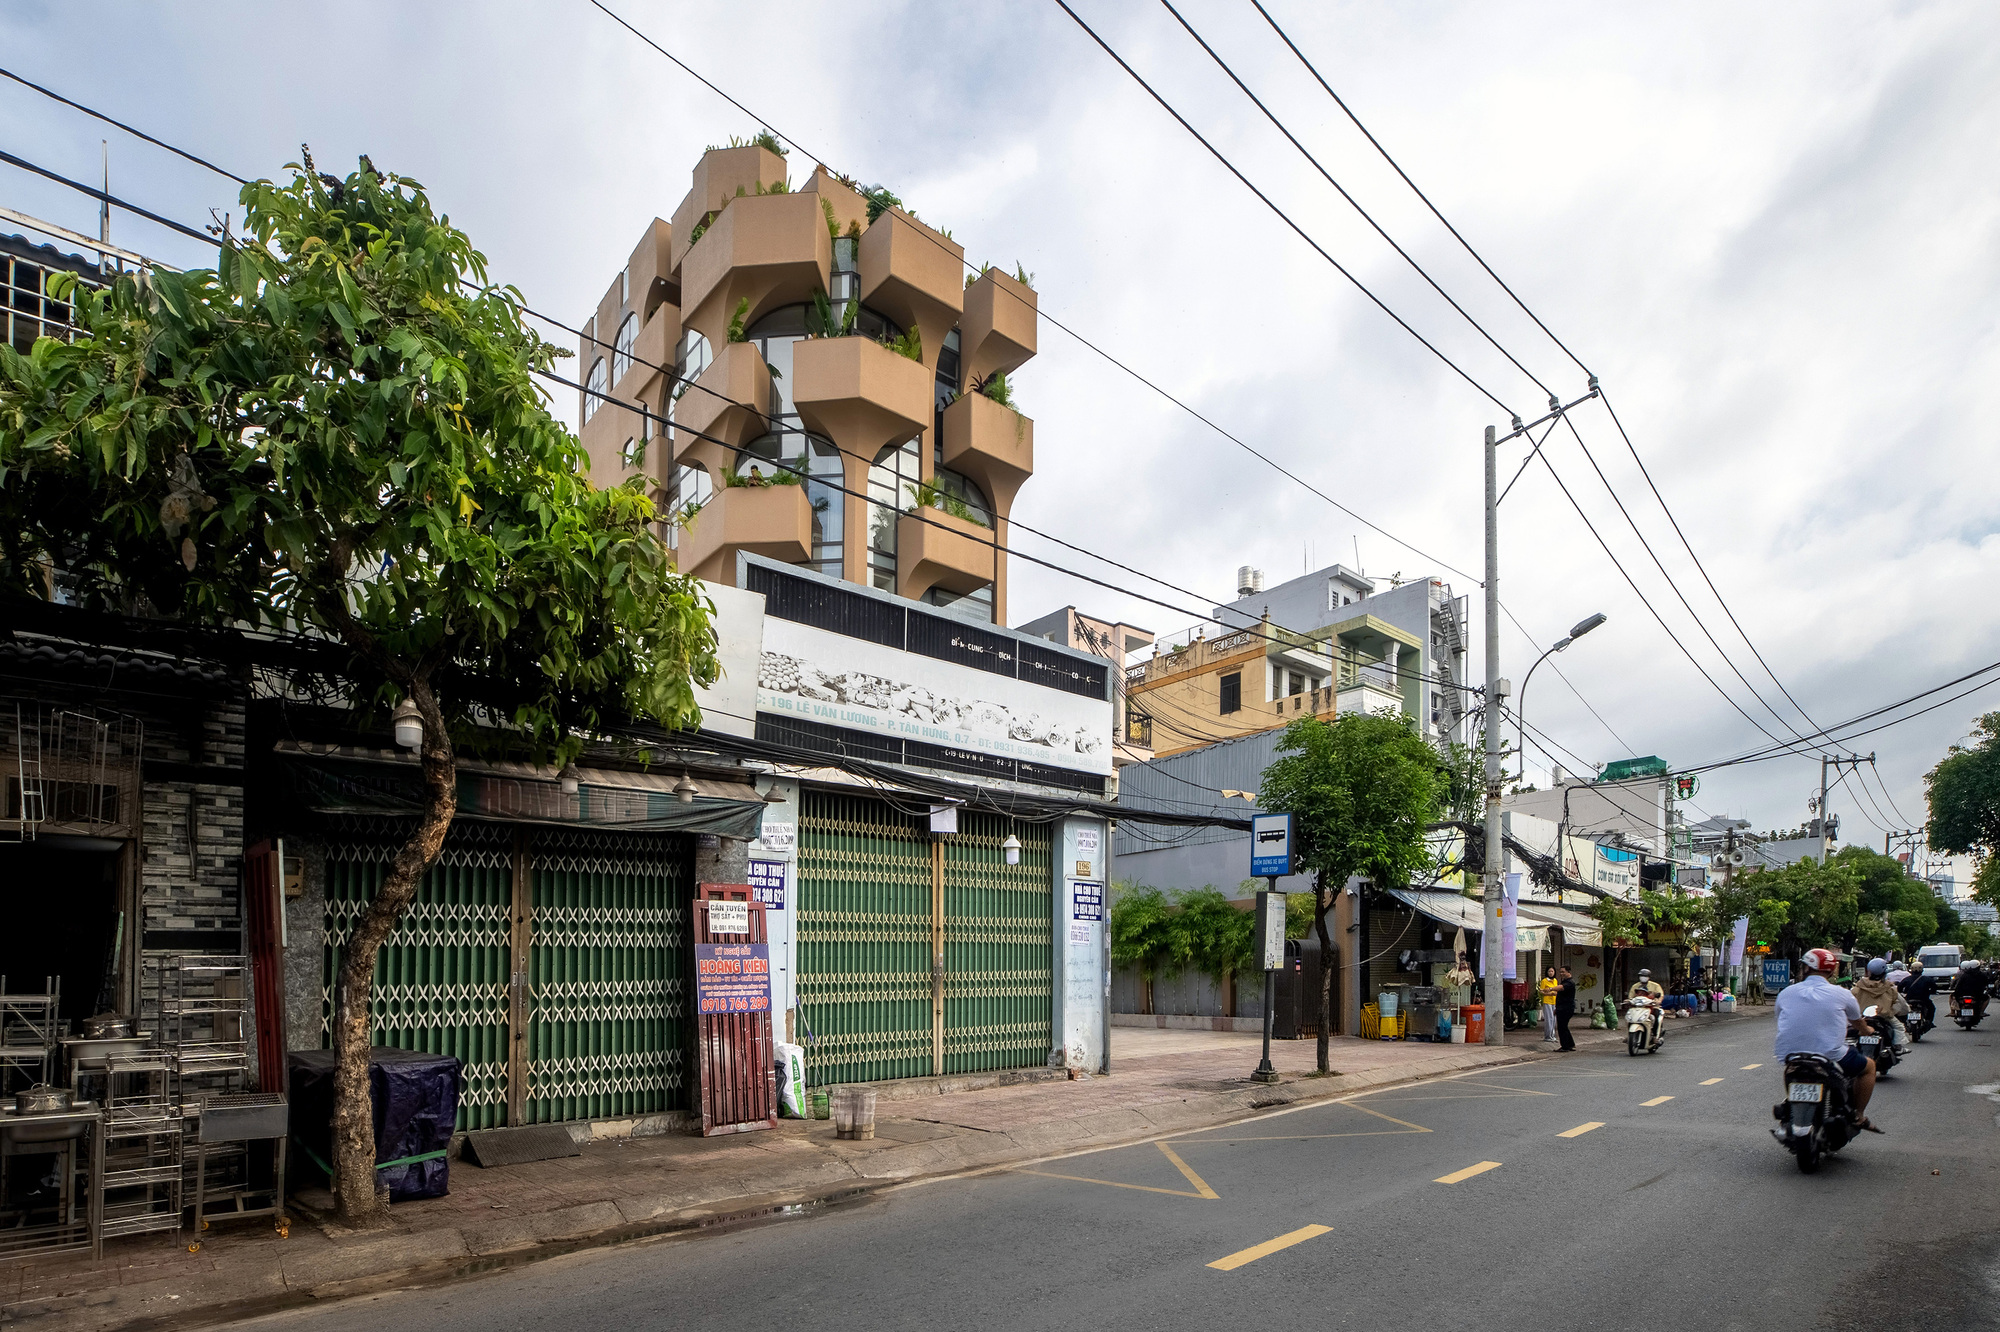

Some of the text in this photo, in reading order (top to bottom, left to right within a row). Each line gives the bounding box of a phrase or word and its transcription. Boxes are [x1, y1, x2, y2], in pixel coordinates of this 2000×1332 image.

[770, 695, 793, 710] 196
[796, 700, 810, 713] LÊ
[813, 704, 838, 719] VĂN
[840, 709, 878, 727] LƯƠNG
[899, 719, 920, 735] TÂN
[954, 732, 970, 745] Q.7
[993, 740, 1015, 753] 0931
[753, 863, 767, 877] CHO
[1078, 862, 1090, 870] 196
[747, 876, 766, 886] GUYÊN
[774, 888, 784, 903] 621
[1083, 885, 1091, 895] CHO
[723, 946, 740, 957] NGHỆ
[743, 956, 768, 974] KIÊN
[1765, 961, 1787, 973] VIỆT
[1765, 974, 1786, 983] NHA
[701, 996, 768, 1011] 0918 766 289
